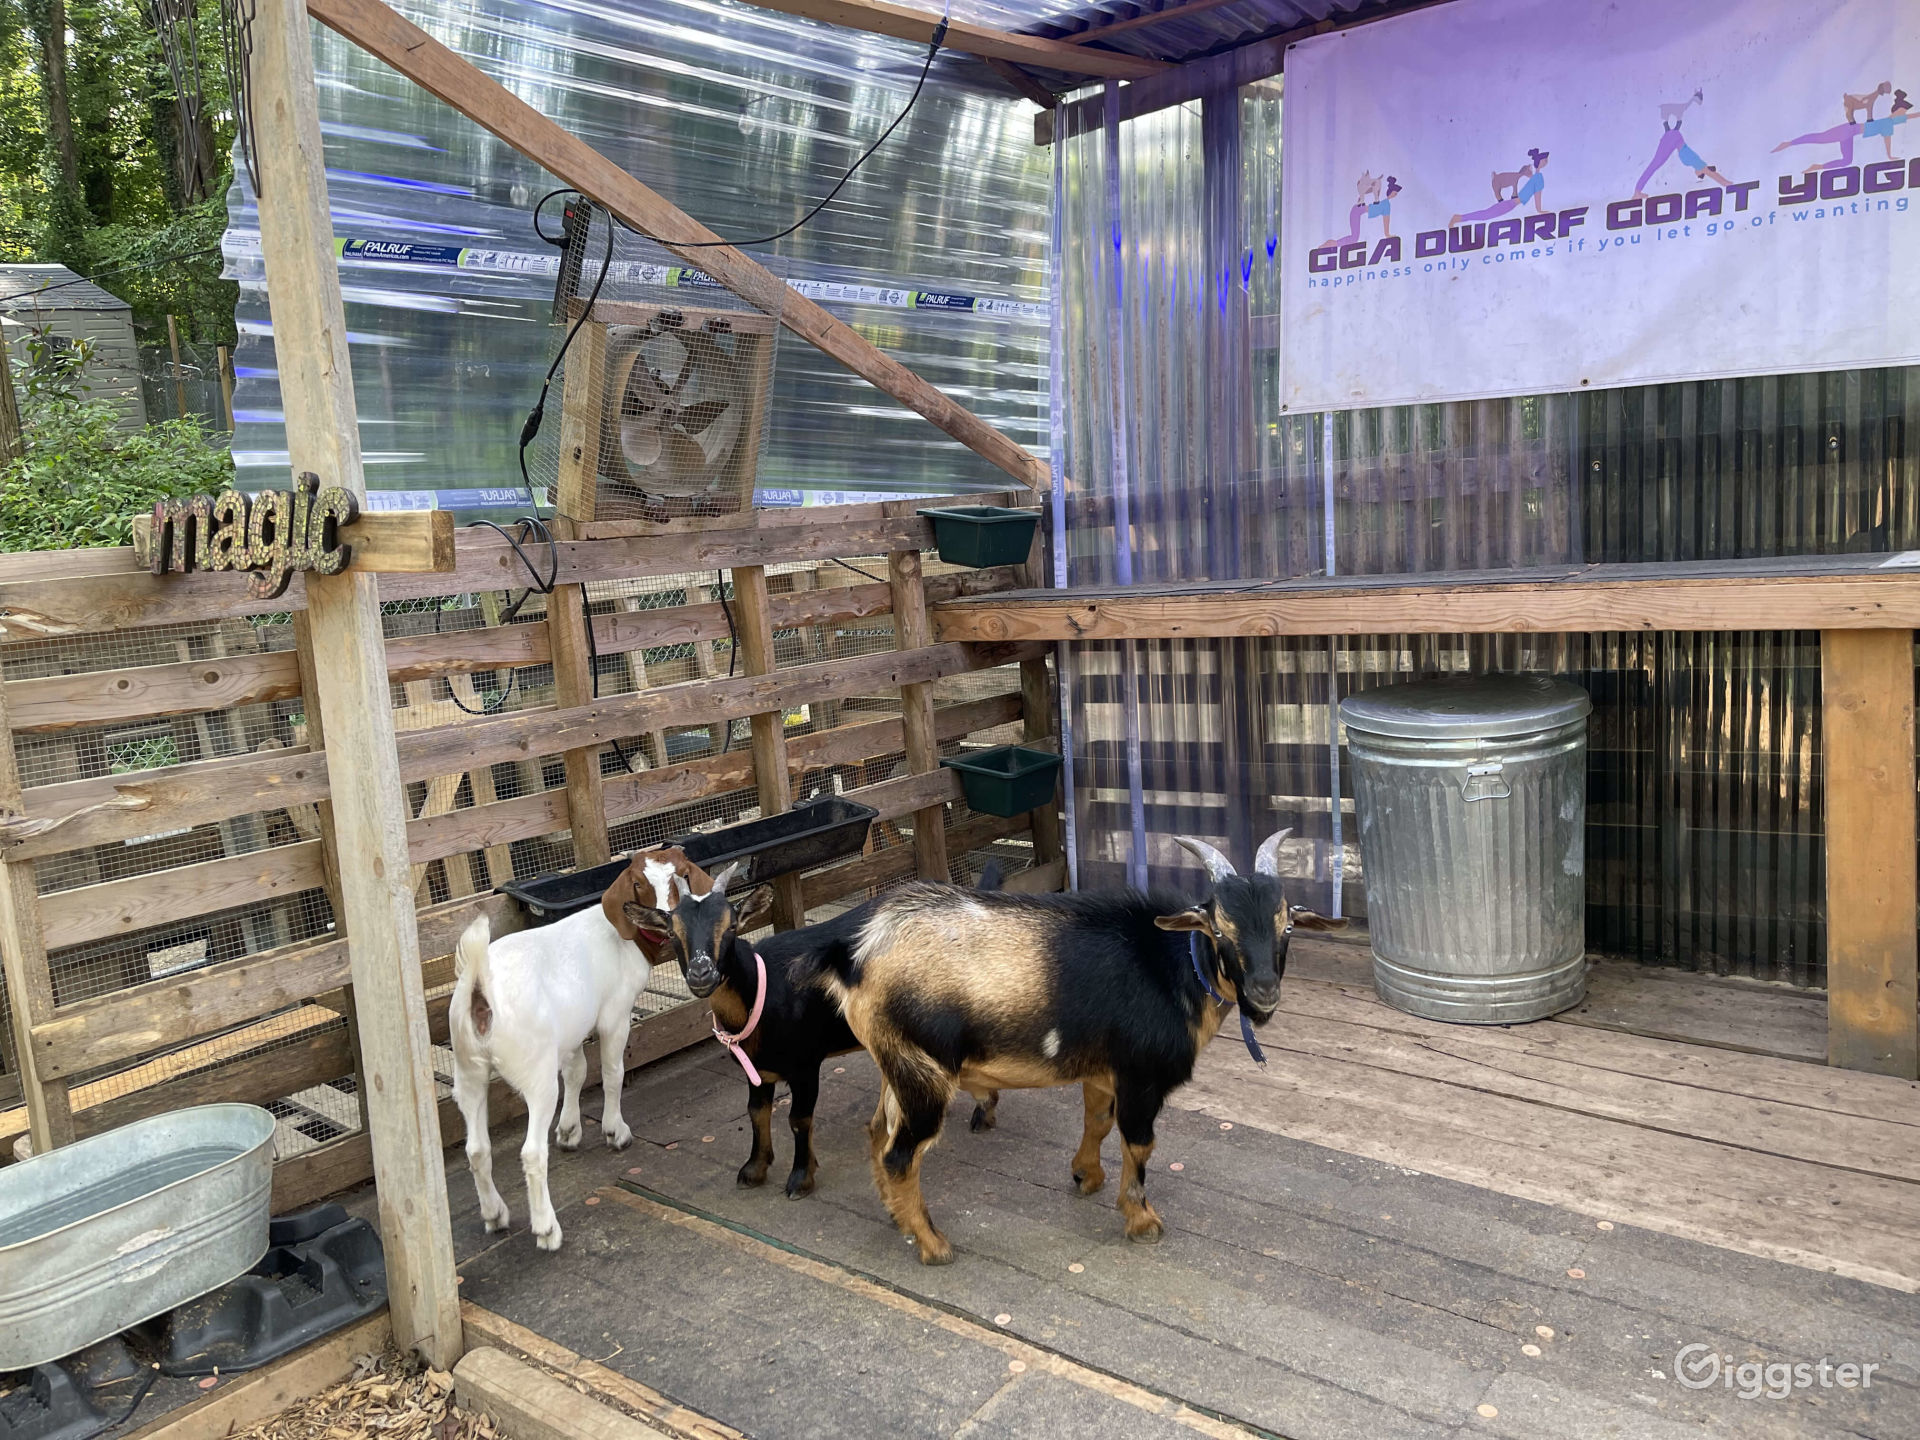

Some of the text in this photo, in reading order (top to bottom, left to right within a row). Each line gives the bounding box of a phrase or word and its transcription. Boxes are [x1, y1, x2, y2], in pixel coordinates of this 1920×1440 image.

[364, 241, 414, 254] PALRUF
[1308, 196, 1909, 288] happiness only comes if you let go of wanting
[1309, 236, 1401, 273] GGA
[1415, 206, 1589, 258] DWARF
[1606, 180, 1760, 231] GOAT
[926, 294, 950, 305] PALRUF
[151, 471, 358, 599] magic
